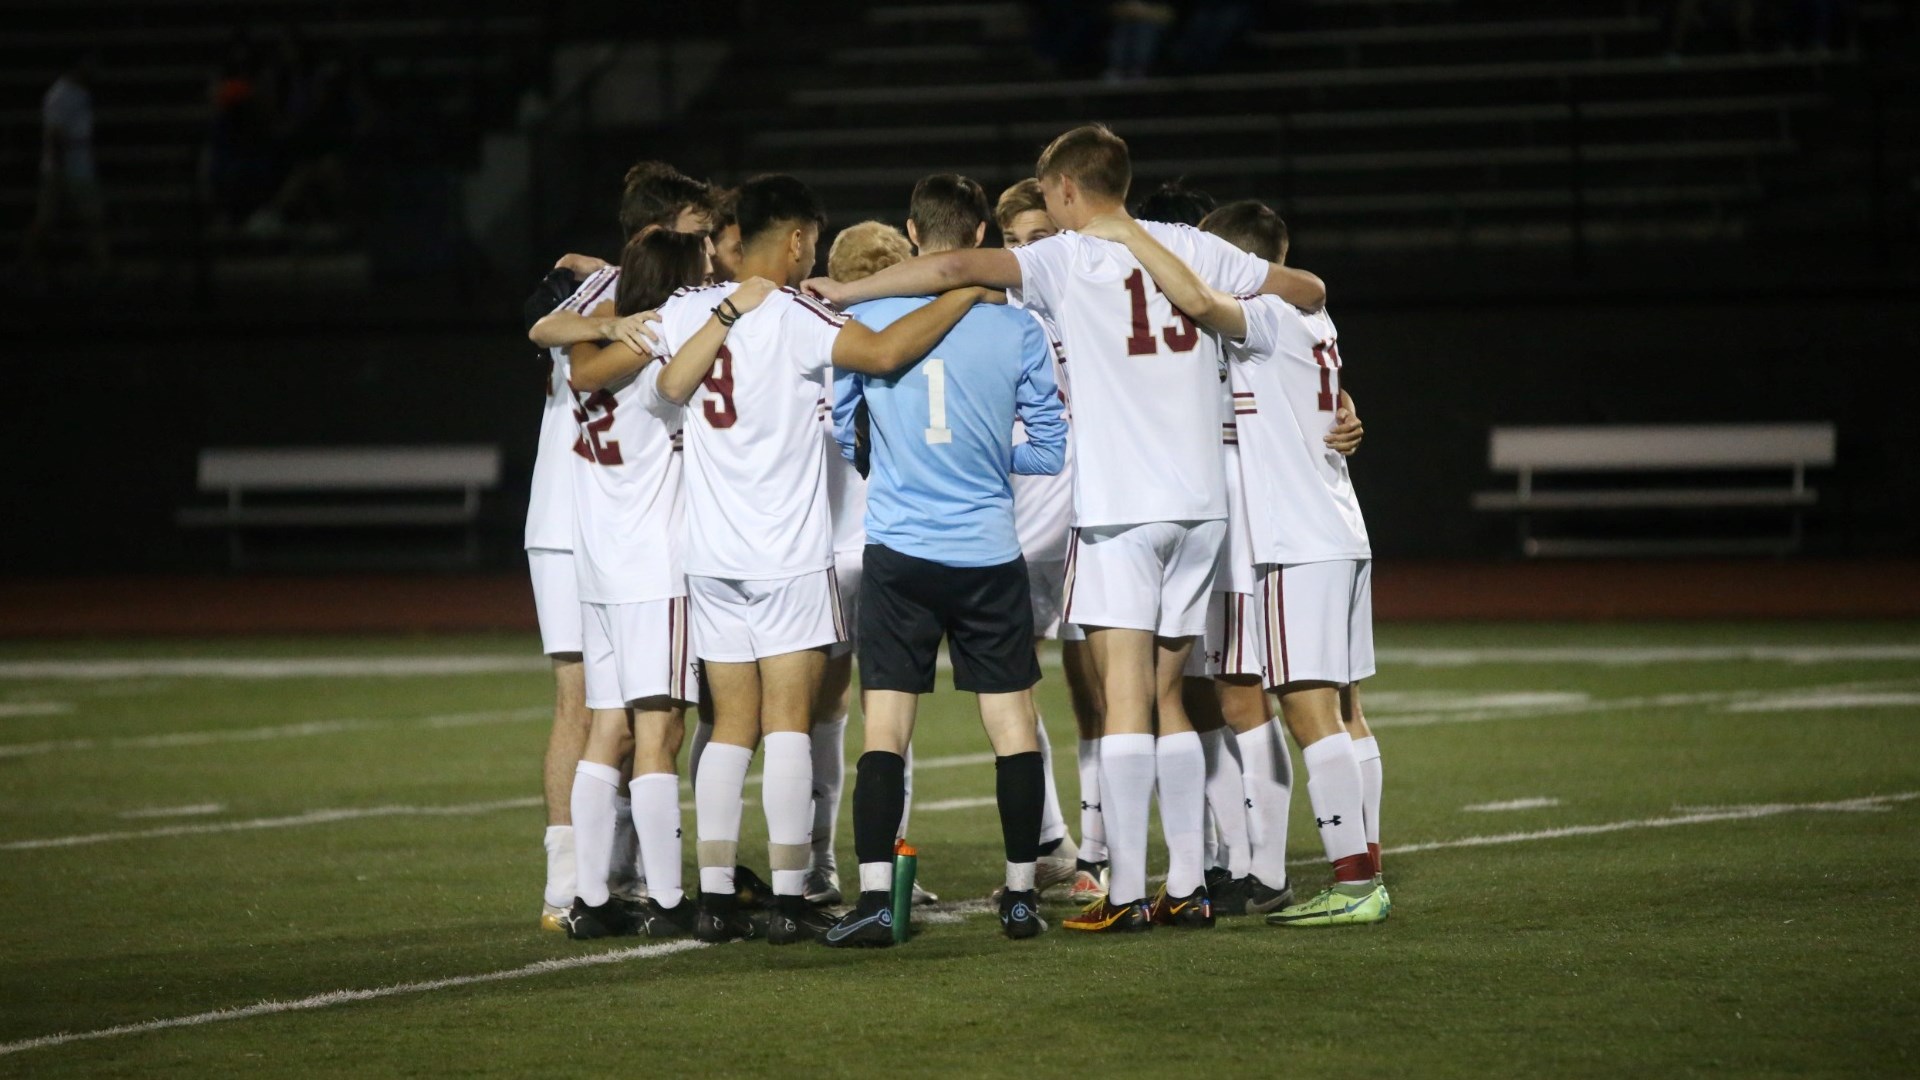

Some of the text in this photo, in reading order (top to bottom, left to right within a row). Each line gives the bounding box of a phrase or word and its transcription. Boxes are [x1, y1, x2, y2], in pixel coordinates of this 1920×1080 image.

[1124, 268, 1199, 356] 13
[567, 379, 625, 466] 22
[701, 344, 738, 429] 9
[922, 358, 953, 445] 1
